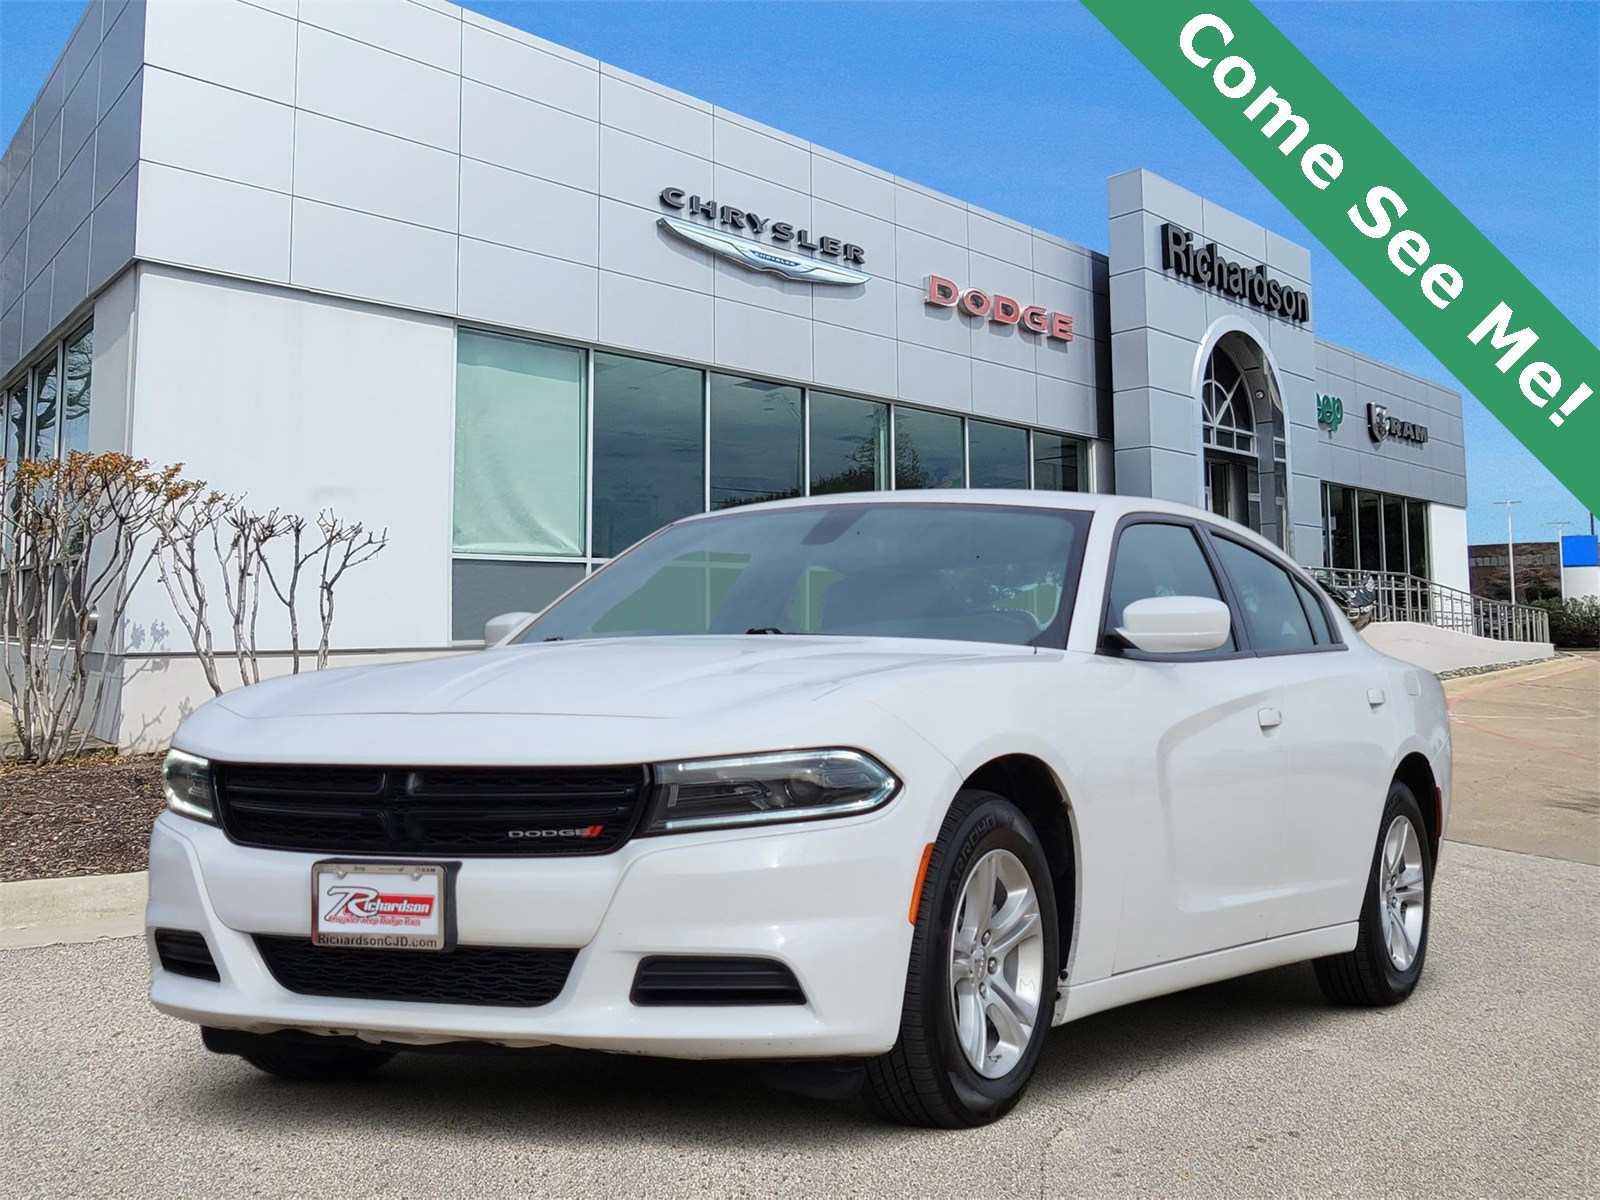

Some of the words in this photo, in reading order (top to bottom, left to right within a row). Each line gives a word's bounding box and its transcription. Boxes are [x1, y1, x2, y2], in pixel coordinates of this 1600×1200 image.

[659, 186, 866, 264] CHRYSLER
[753, 252, 798, 267] CHRYSLER
[1161, 223, 1310, 322] Richardson
[924, 274, 1074, 342] DODGE
[1388, 416, 1429, 443] RAM
[508, 828, 590, 838] DODGE
[949, 815, 996, 897] ARROYO
[324, 886, 430, 920] Richardson
[317, 934, 437, 948] RichardsonCJD.com
